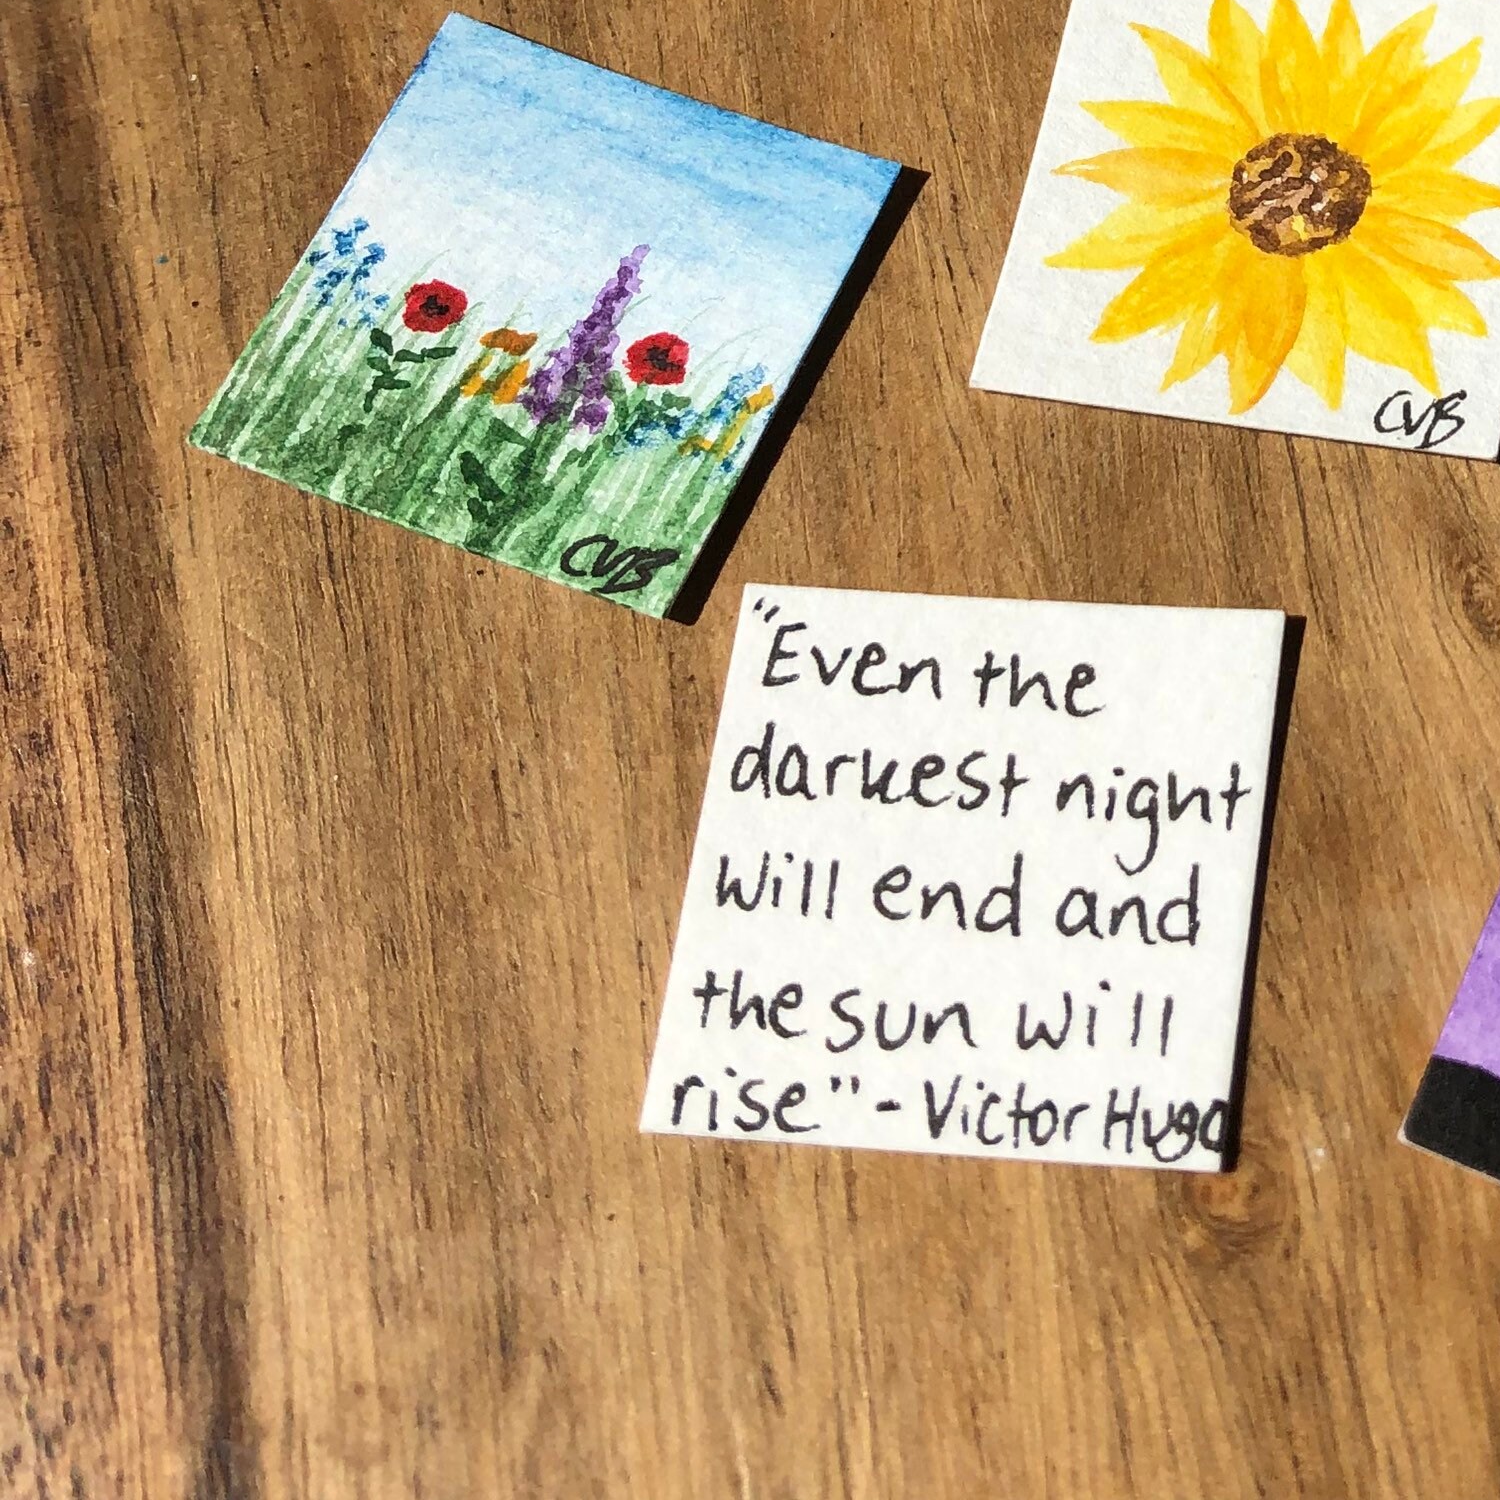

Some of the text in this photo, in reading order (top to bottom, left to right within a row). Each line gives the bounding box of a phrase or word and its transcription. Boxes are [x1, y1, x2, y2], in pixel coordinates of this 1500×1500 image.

[753, 596, 1105, 717] "Even the
[730, 721, 1251, 876] darkest night
[873, 851, 1022, 937] end
[1054, 863, 1201, 946] and
[692, 971, 808, 1039] the
[826, 986, 977, 1053] sun
[923, 1074, 1090, 1148] Victor
